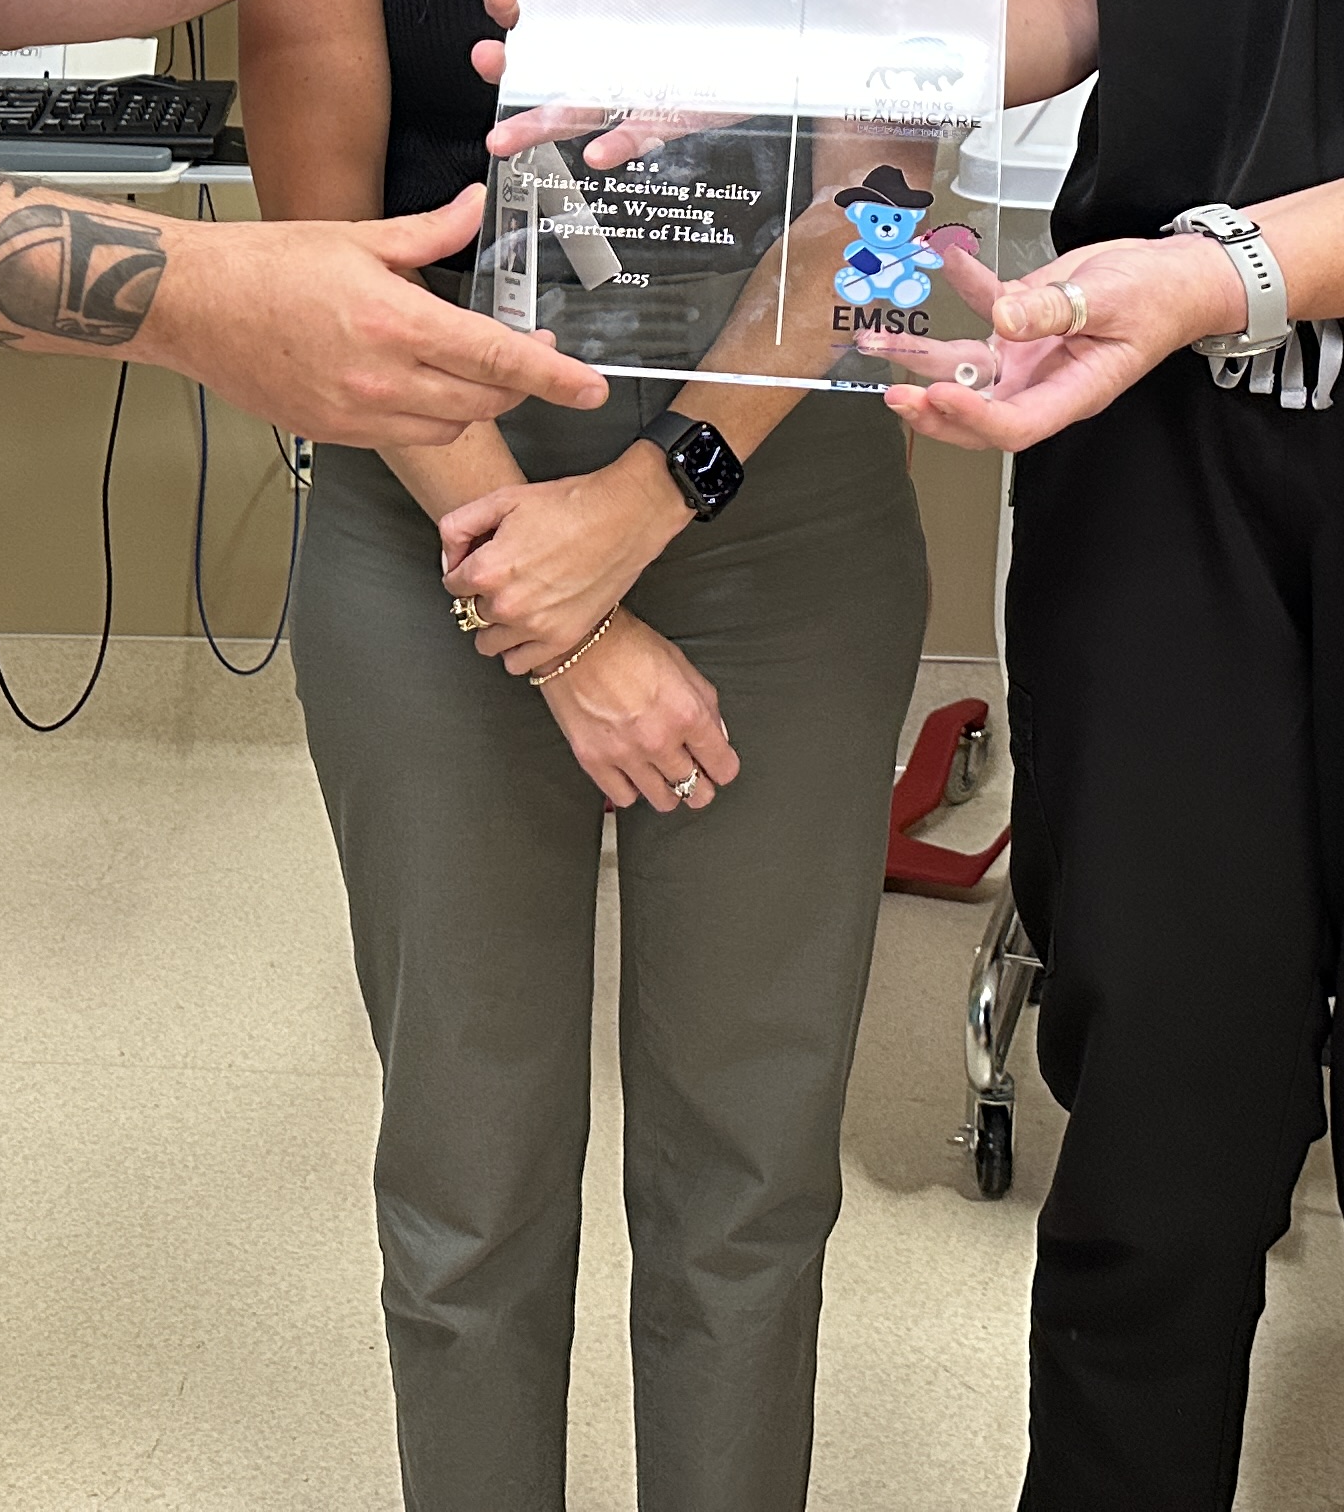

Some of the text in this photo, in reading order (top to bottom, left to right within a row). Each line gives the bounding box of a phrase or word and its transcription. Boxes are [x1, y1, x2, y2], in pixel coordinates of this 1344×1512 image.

[874, 98, 954, 112] WYOMING
[844, 108, 983, 129] HEALTHCARE
[626, 161, 660, 174] as a
[521, 172, 599, 192] Pediatric
[604, 177, 690, 201] Receiving
[694, 182, 762, 206] Facility
[563, 196, 715, 225] by the Wyoming
[538, 217, 736, 245] Department of Health
[612, 272, 650, 288] 2025
[832, 305, 930, 336] EMSC
